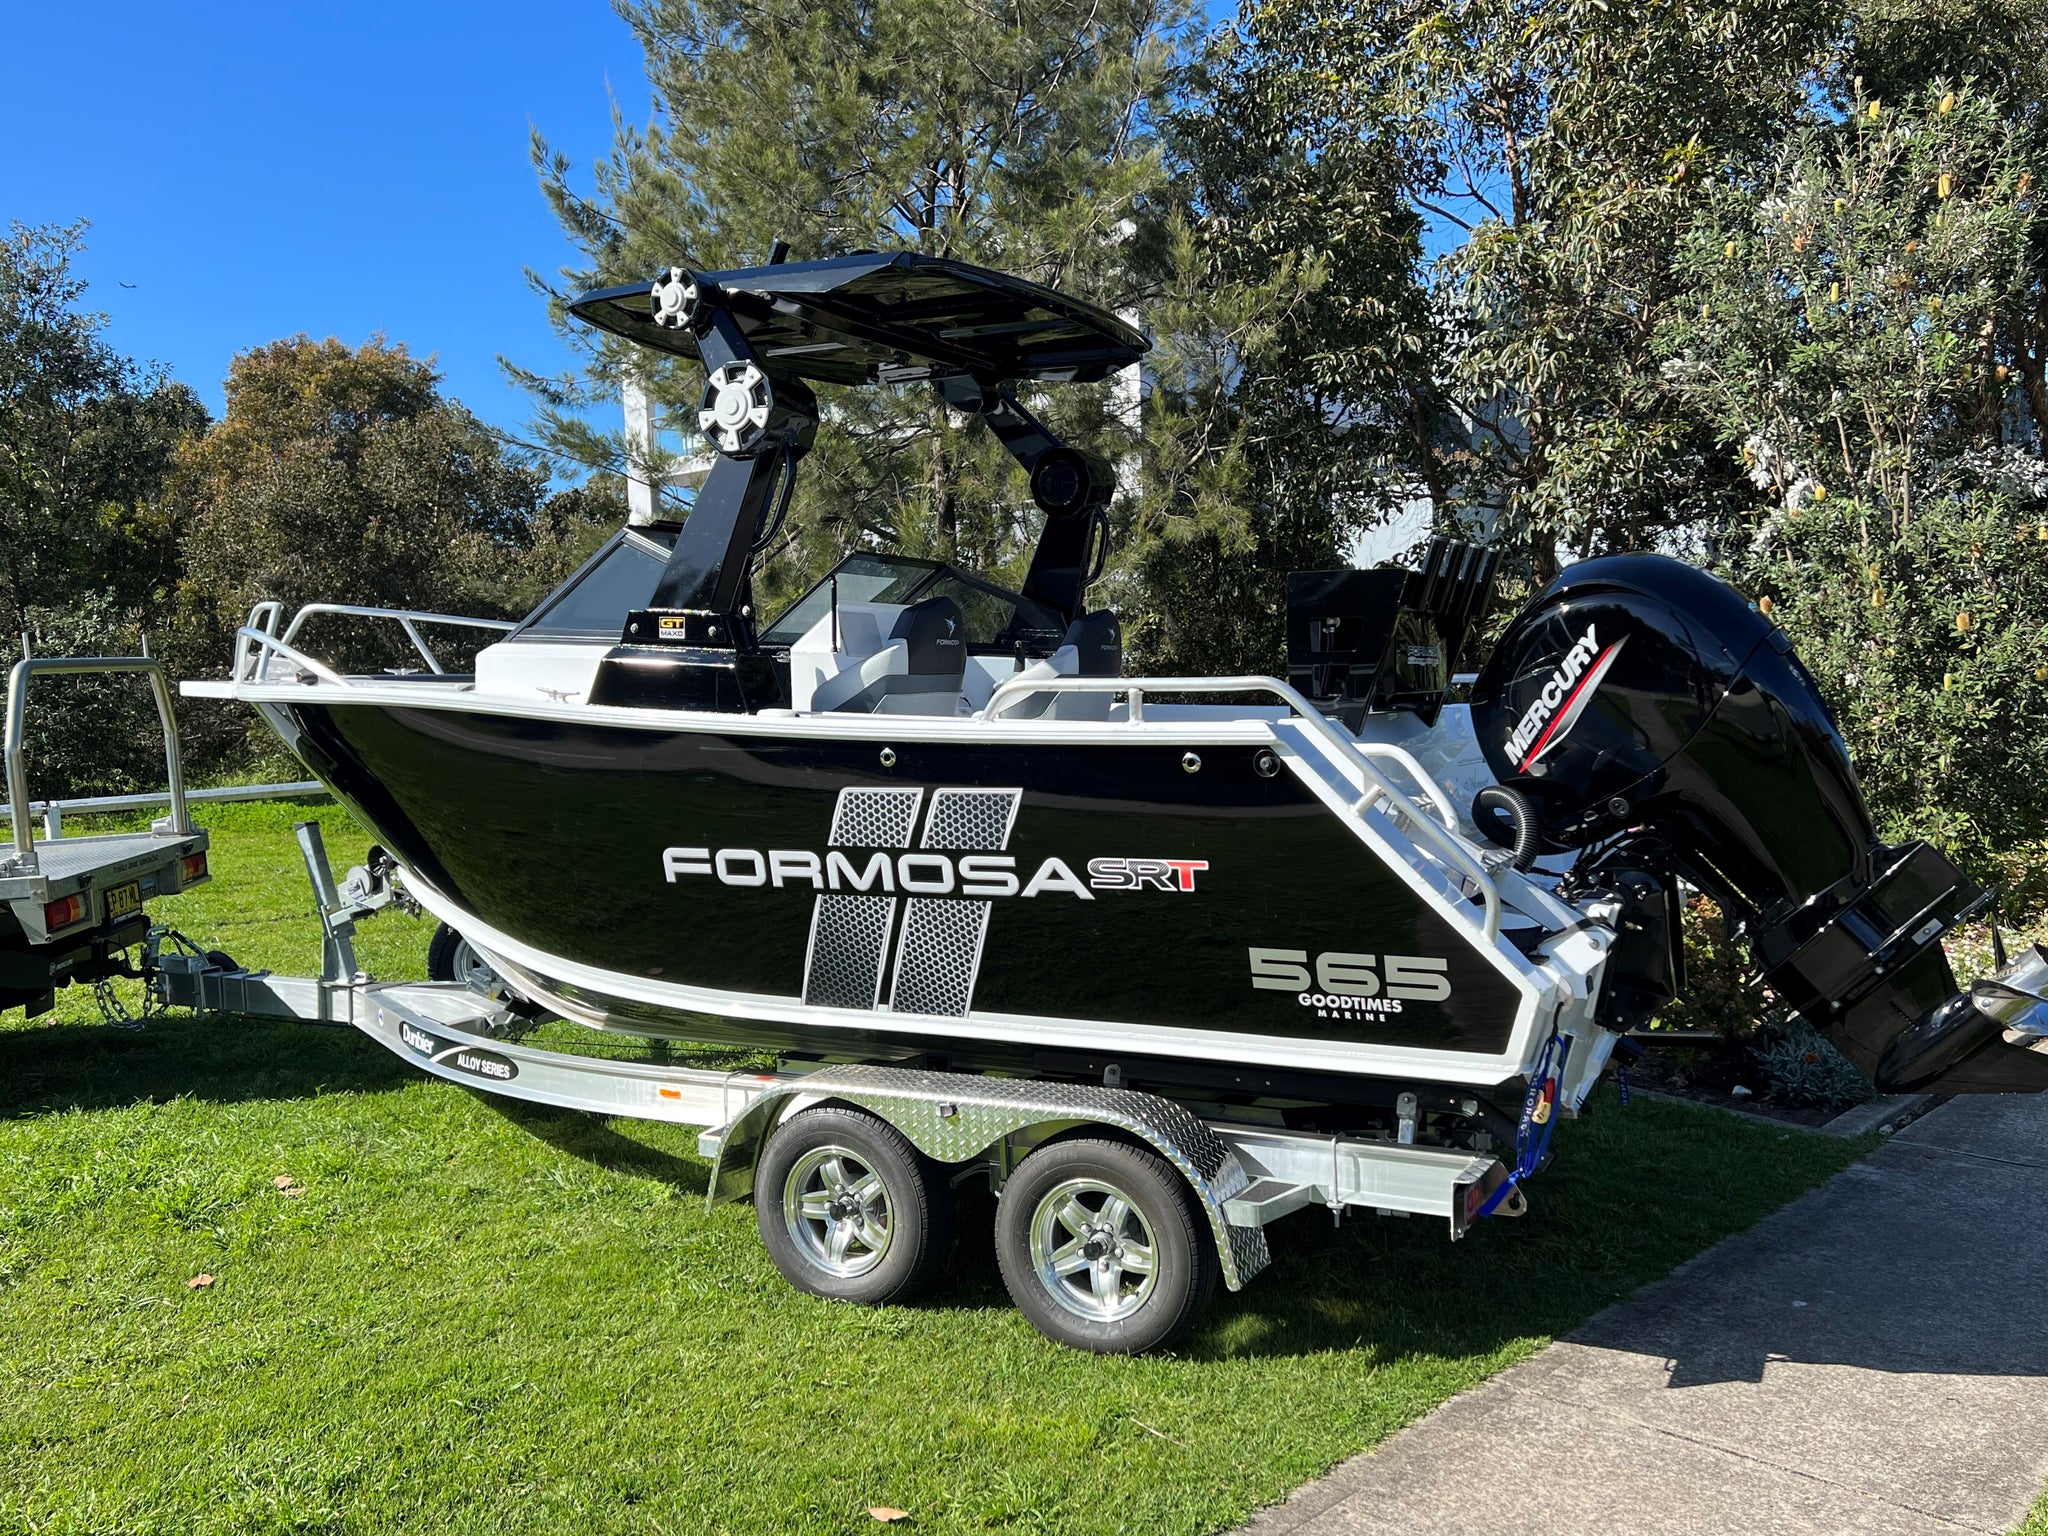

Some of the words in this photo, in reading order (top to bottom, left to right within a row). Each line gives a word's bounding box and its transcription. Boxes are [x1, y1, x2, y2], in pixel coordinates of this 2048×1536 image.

[661, 618, 684, 628] GT
[1503, 623, 1600, 766] MERCURY
[662, 847, 1094, 900] FORMOSA
[1088, 857, 1210, 892] SRT
[1248, 947, 1452, 1002] 565
[1298, 993, 1403, 1013] GOODTIMES
[1317, 1008, 1386, 1022] MARINE
[403, 1024, 435, 1054] Dunbier
[457, 1053, 482, 1071] ALLOY
[481, 1060, 510, 1079] SERIES
